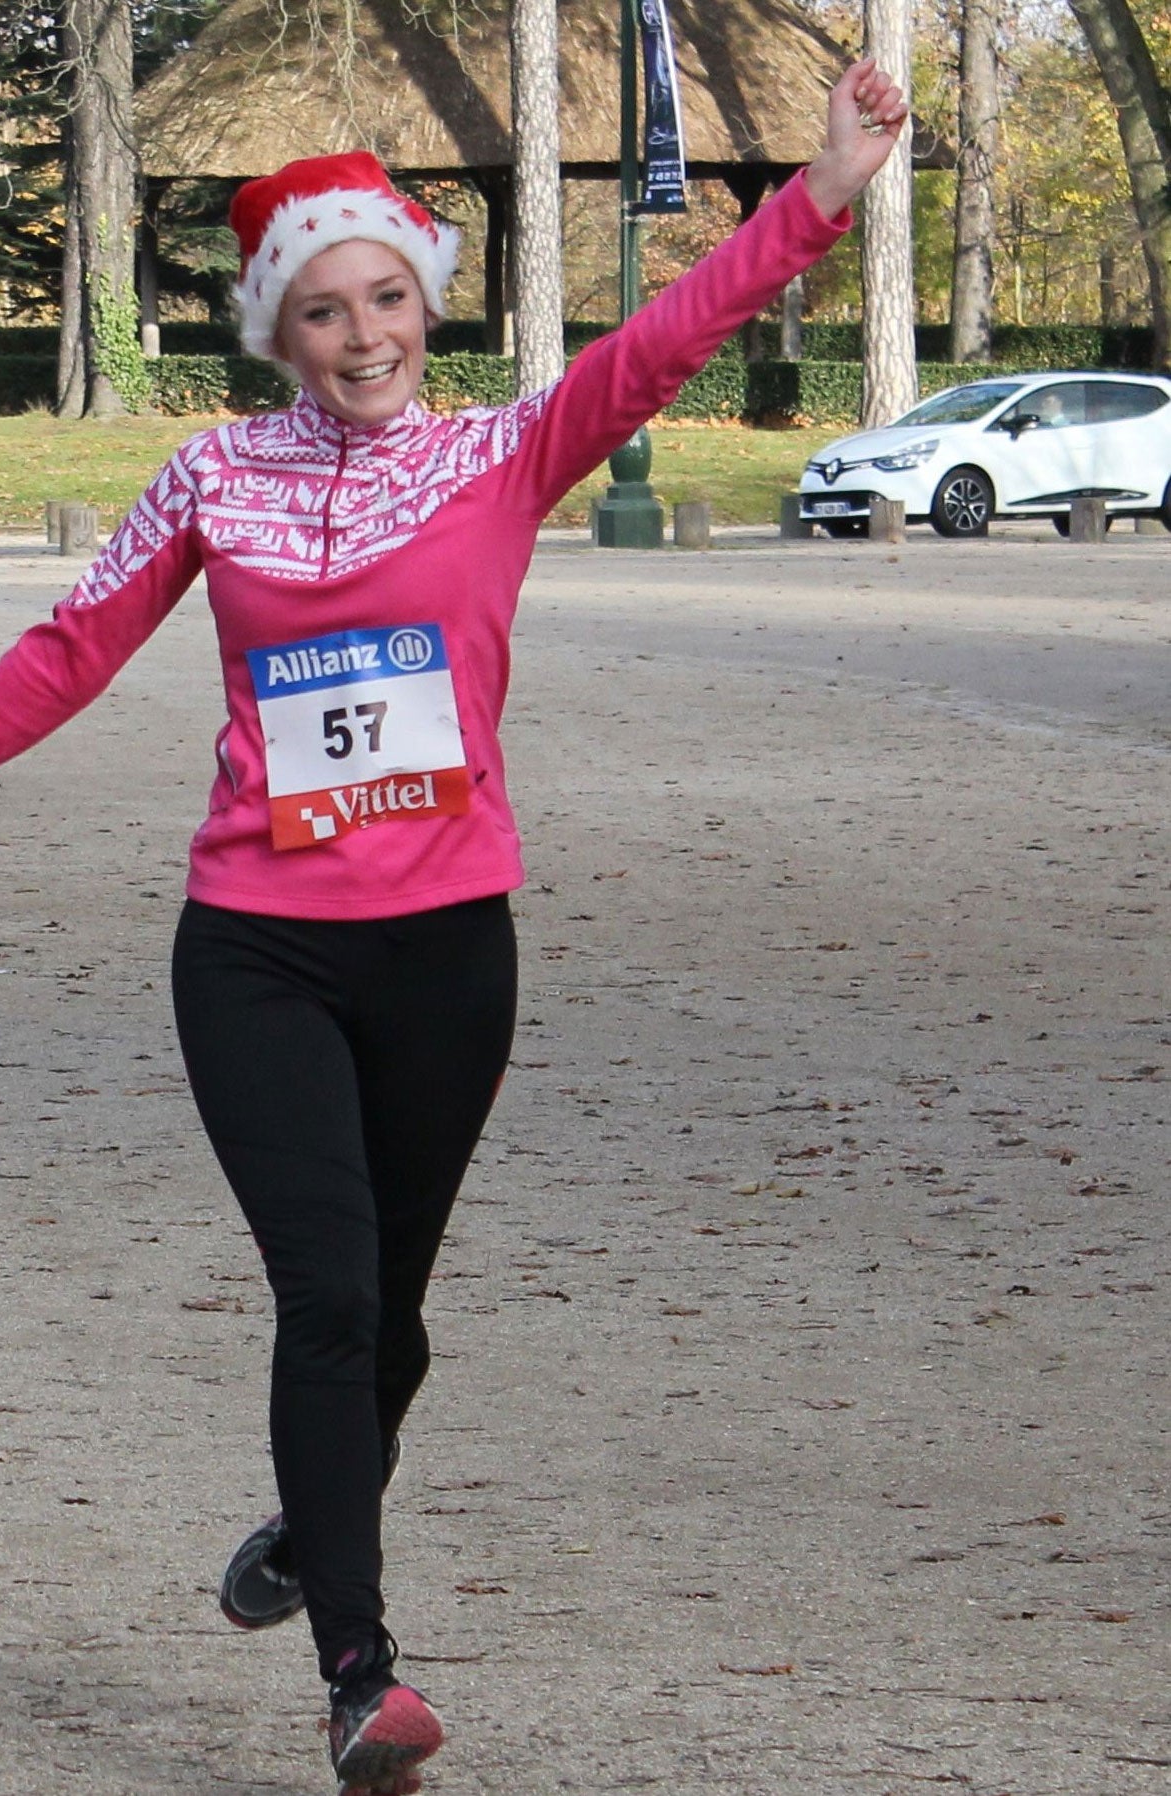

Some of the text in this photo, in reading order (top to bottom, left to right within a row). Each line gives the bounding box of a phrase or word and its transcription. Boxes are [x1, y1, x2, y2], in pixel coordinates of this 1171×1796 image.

[267, 643, 381, 687] Allianz
[323, 701, 388, 759] 57
[330, 775, 437, 824] Vittel
